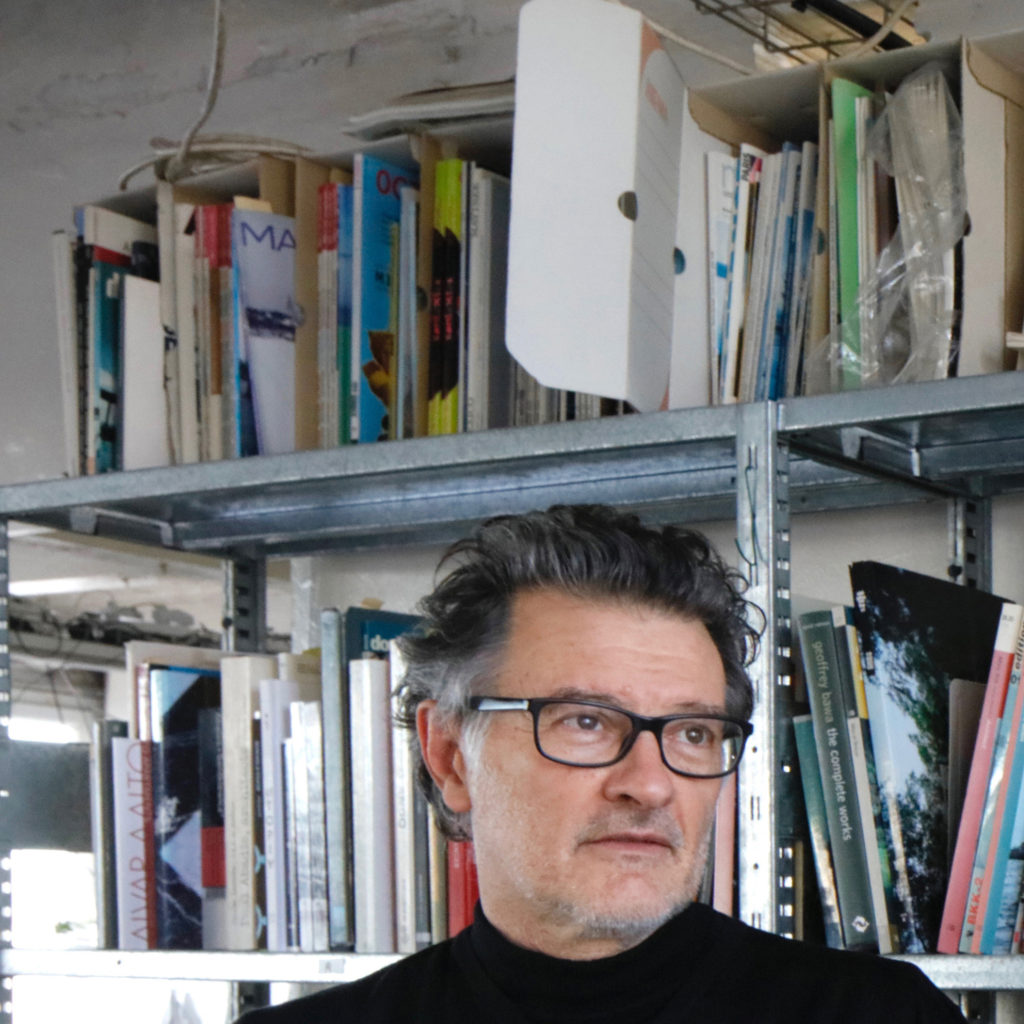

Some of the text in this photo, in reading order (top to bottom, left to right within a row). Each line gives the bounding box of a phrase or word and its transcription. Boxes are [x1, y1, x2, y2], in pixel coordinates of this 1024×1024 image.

[811, 640, 835, 724] geoffrey bawa
[826, 727, 853, 842] the complete works
